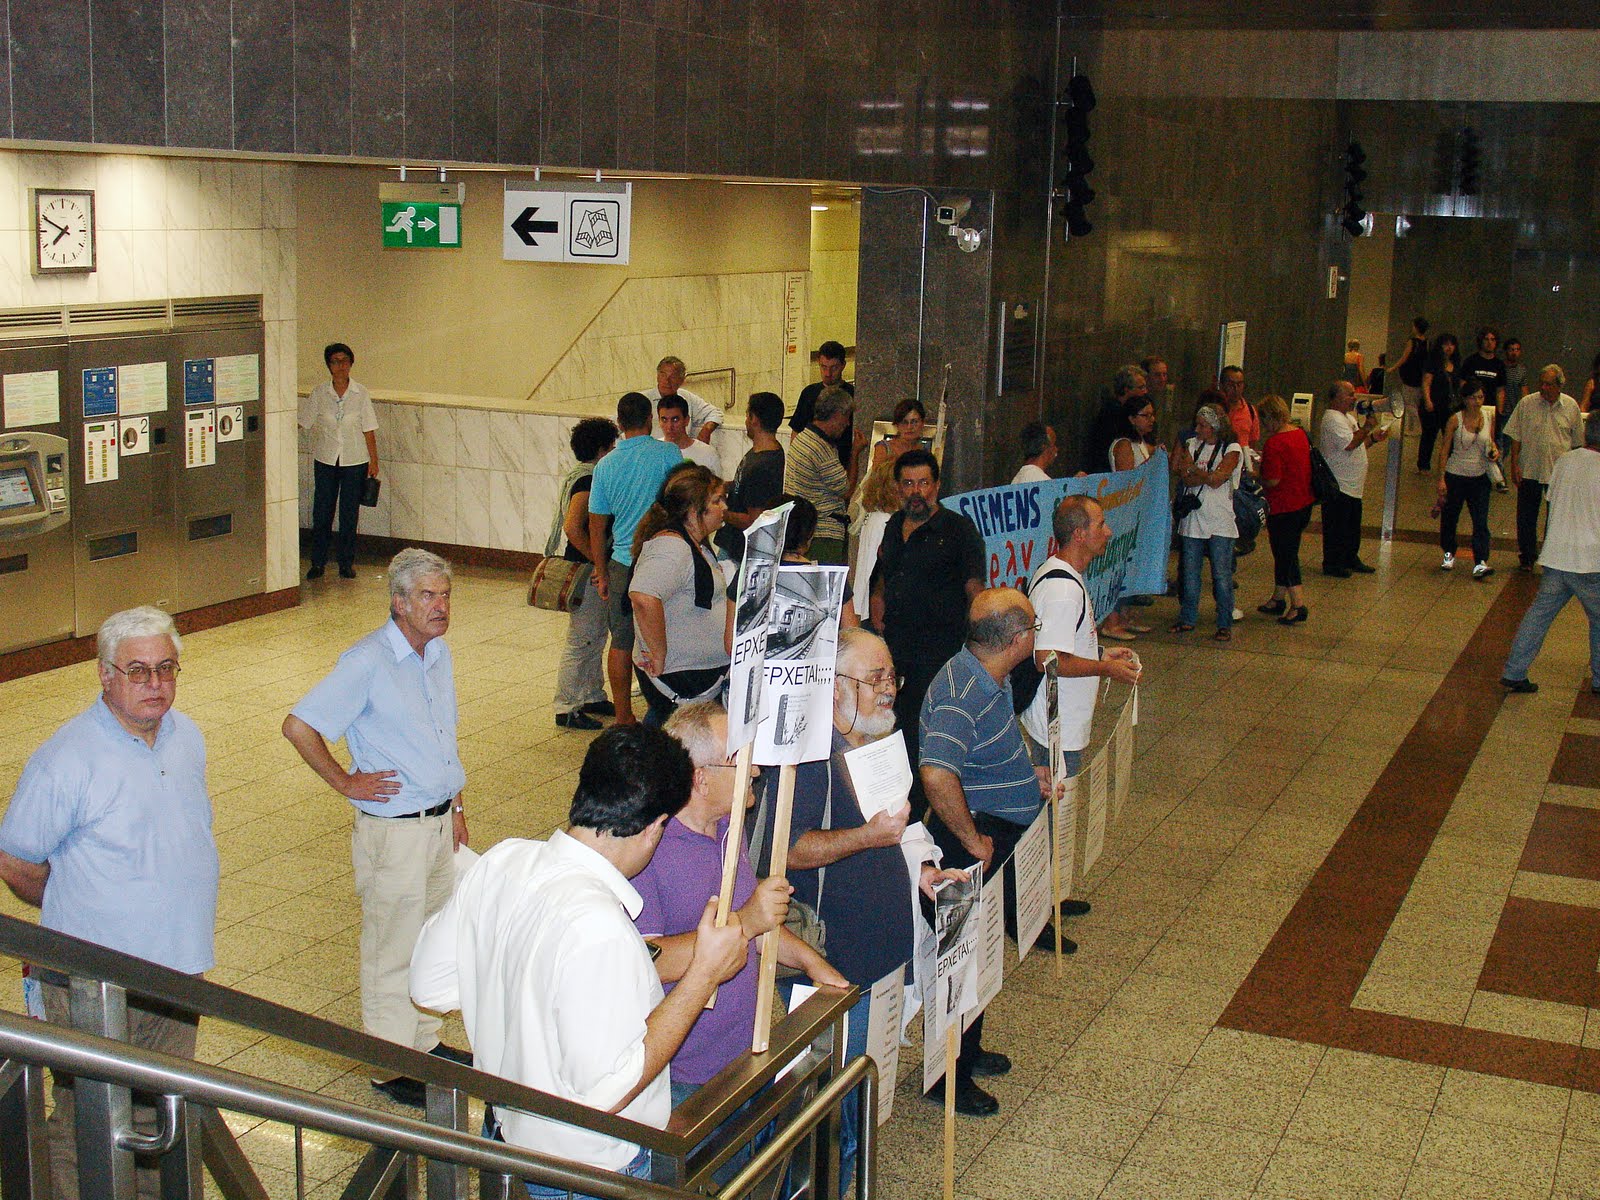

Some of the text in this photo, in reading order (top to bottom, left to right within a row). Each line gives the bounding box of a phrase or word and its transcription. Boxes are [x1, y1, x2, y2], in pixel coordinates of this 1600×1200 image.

[235, 407, 242, 422] 2
[110, 422, 116, 437] 1
[140, 418, 148, 434] 2
[959, 486, 1041, 537] SIEMENS
